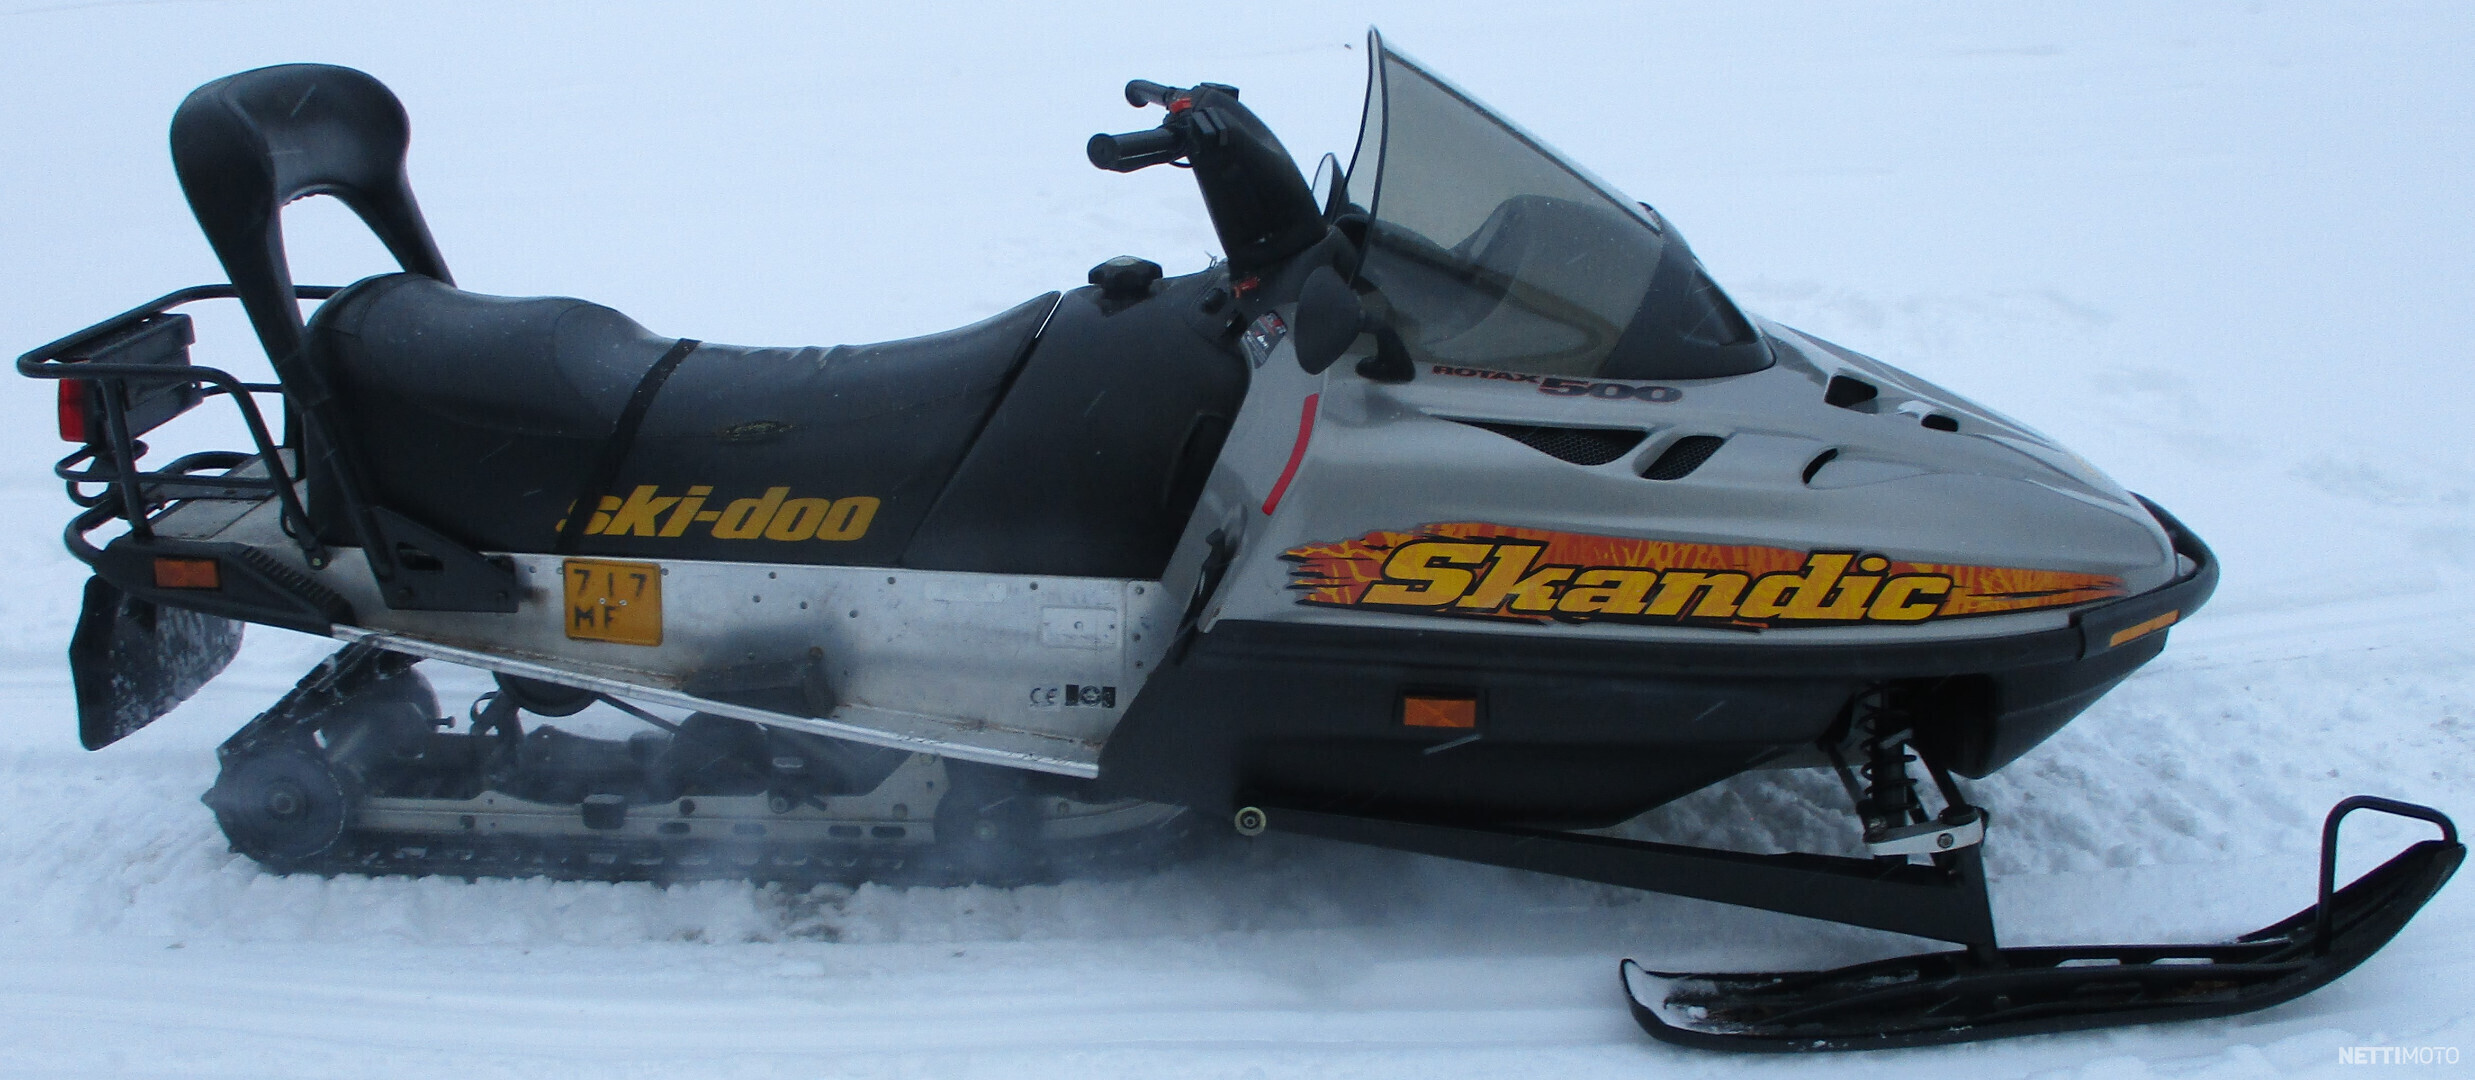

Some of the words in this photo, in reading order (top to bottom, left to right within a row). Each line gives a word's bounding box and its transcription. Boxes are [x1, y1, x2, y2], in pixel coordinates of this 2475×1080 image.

[1432, 365, 1540, 384] ROTAX
[1537, 377, 1683, 402] 500
[573, 569, 647, 597] 717
[1361, 537, 1956, 622] Skandic
